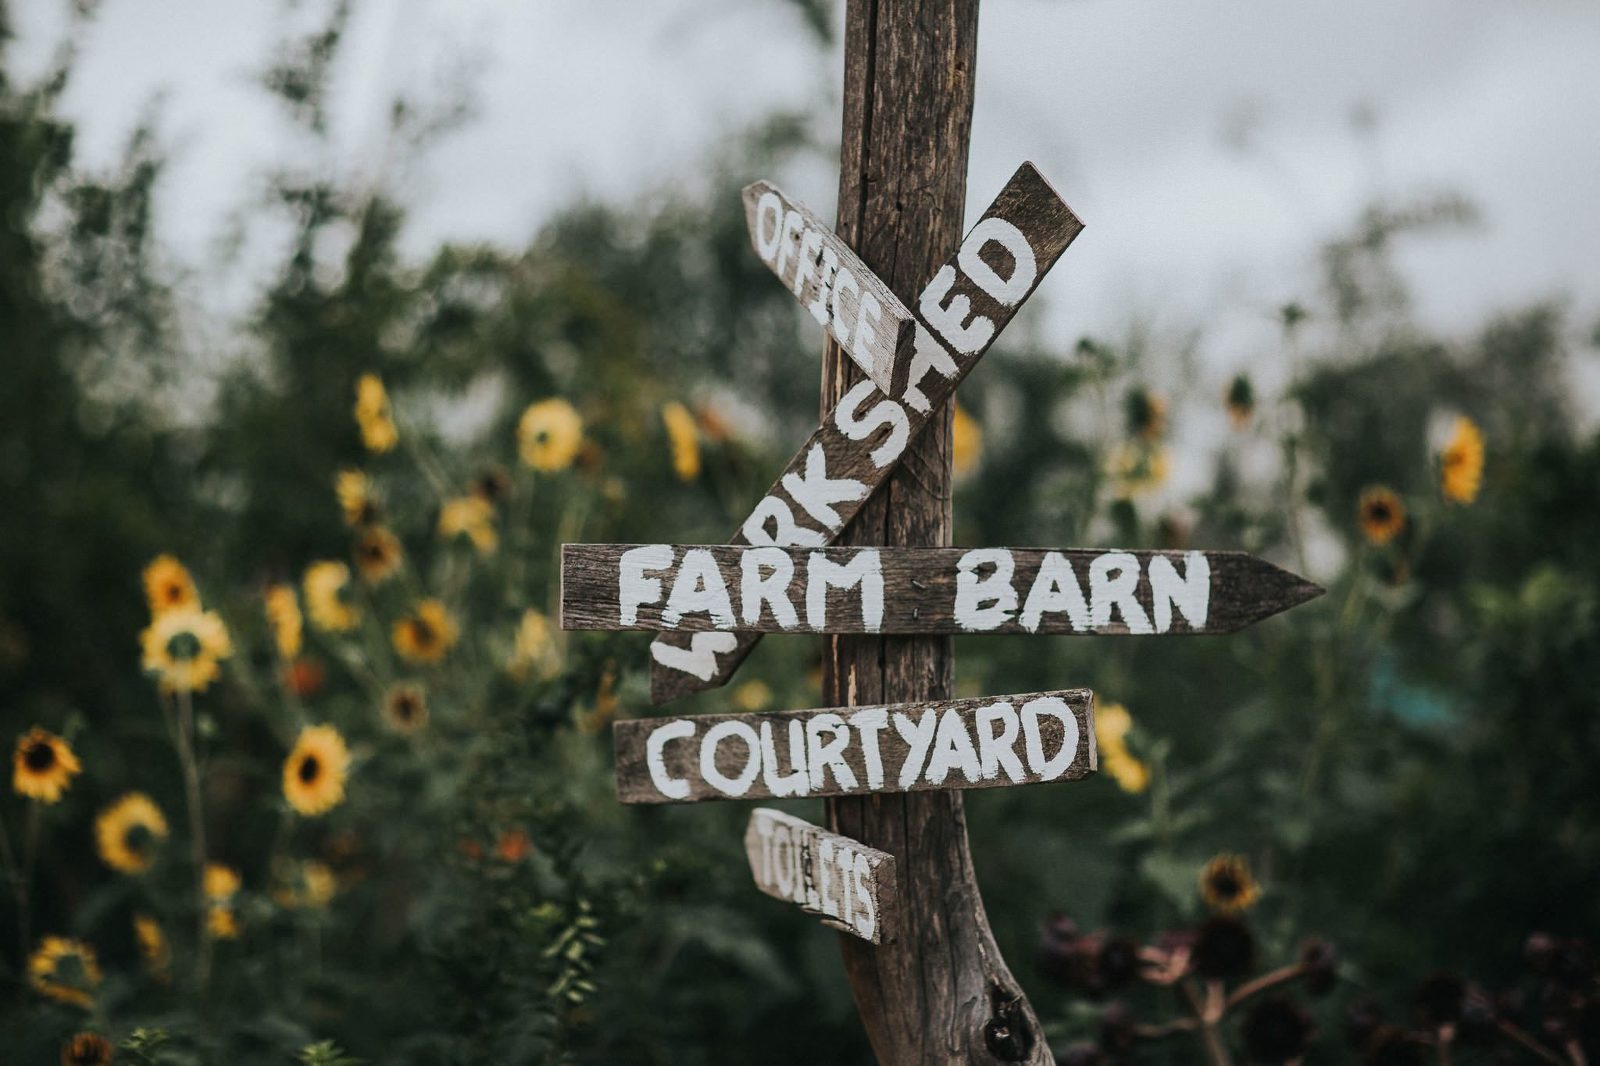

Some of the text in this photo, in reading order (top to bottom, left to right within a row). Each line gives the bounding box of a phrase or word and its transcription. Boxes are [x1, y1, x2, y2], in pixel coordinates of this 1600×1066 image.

[756, 192, 882, 374] OFFICE
[618, 544, 1211, 635] FARM BARN
[646, 696, 1080, 800] COURTYARD
[756, 814, 876, 941] TOILETS
